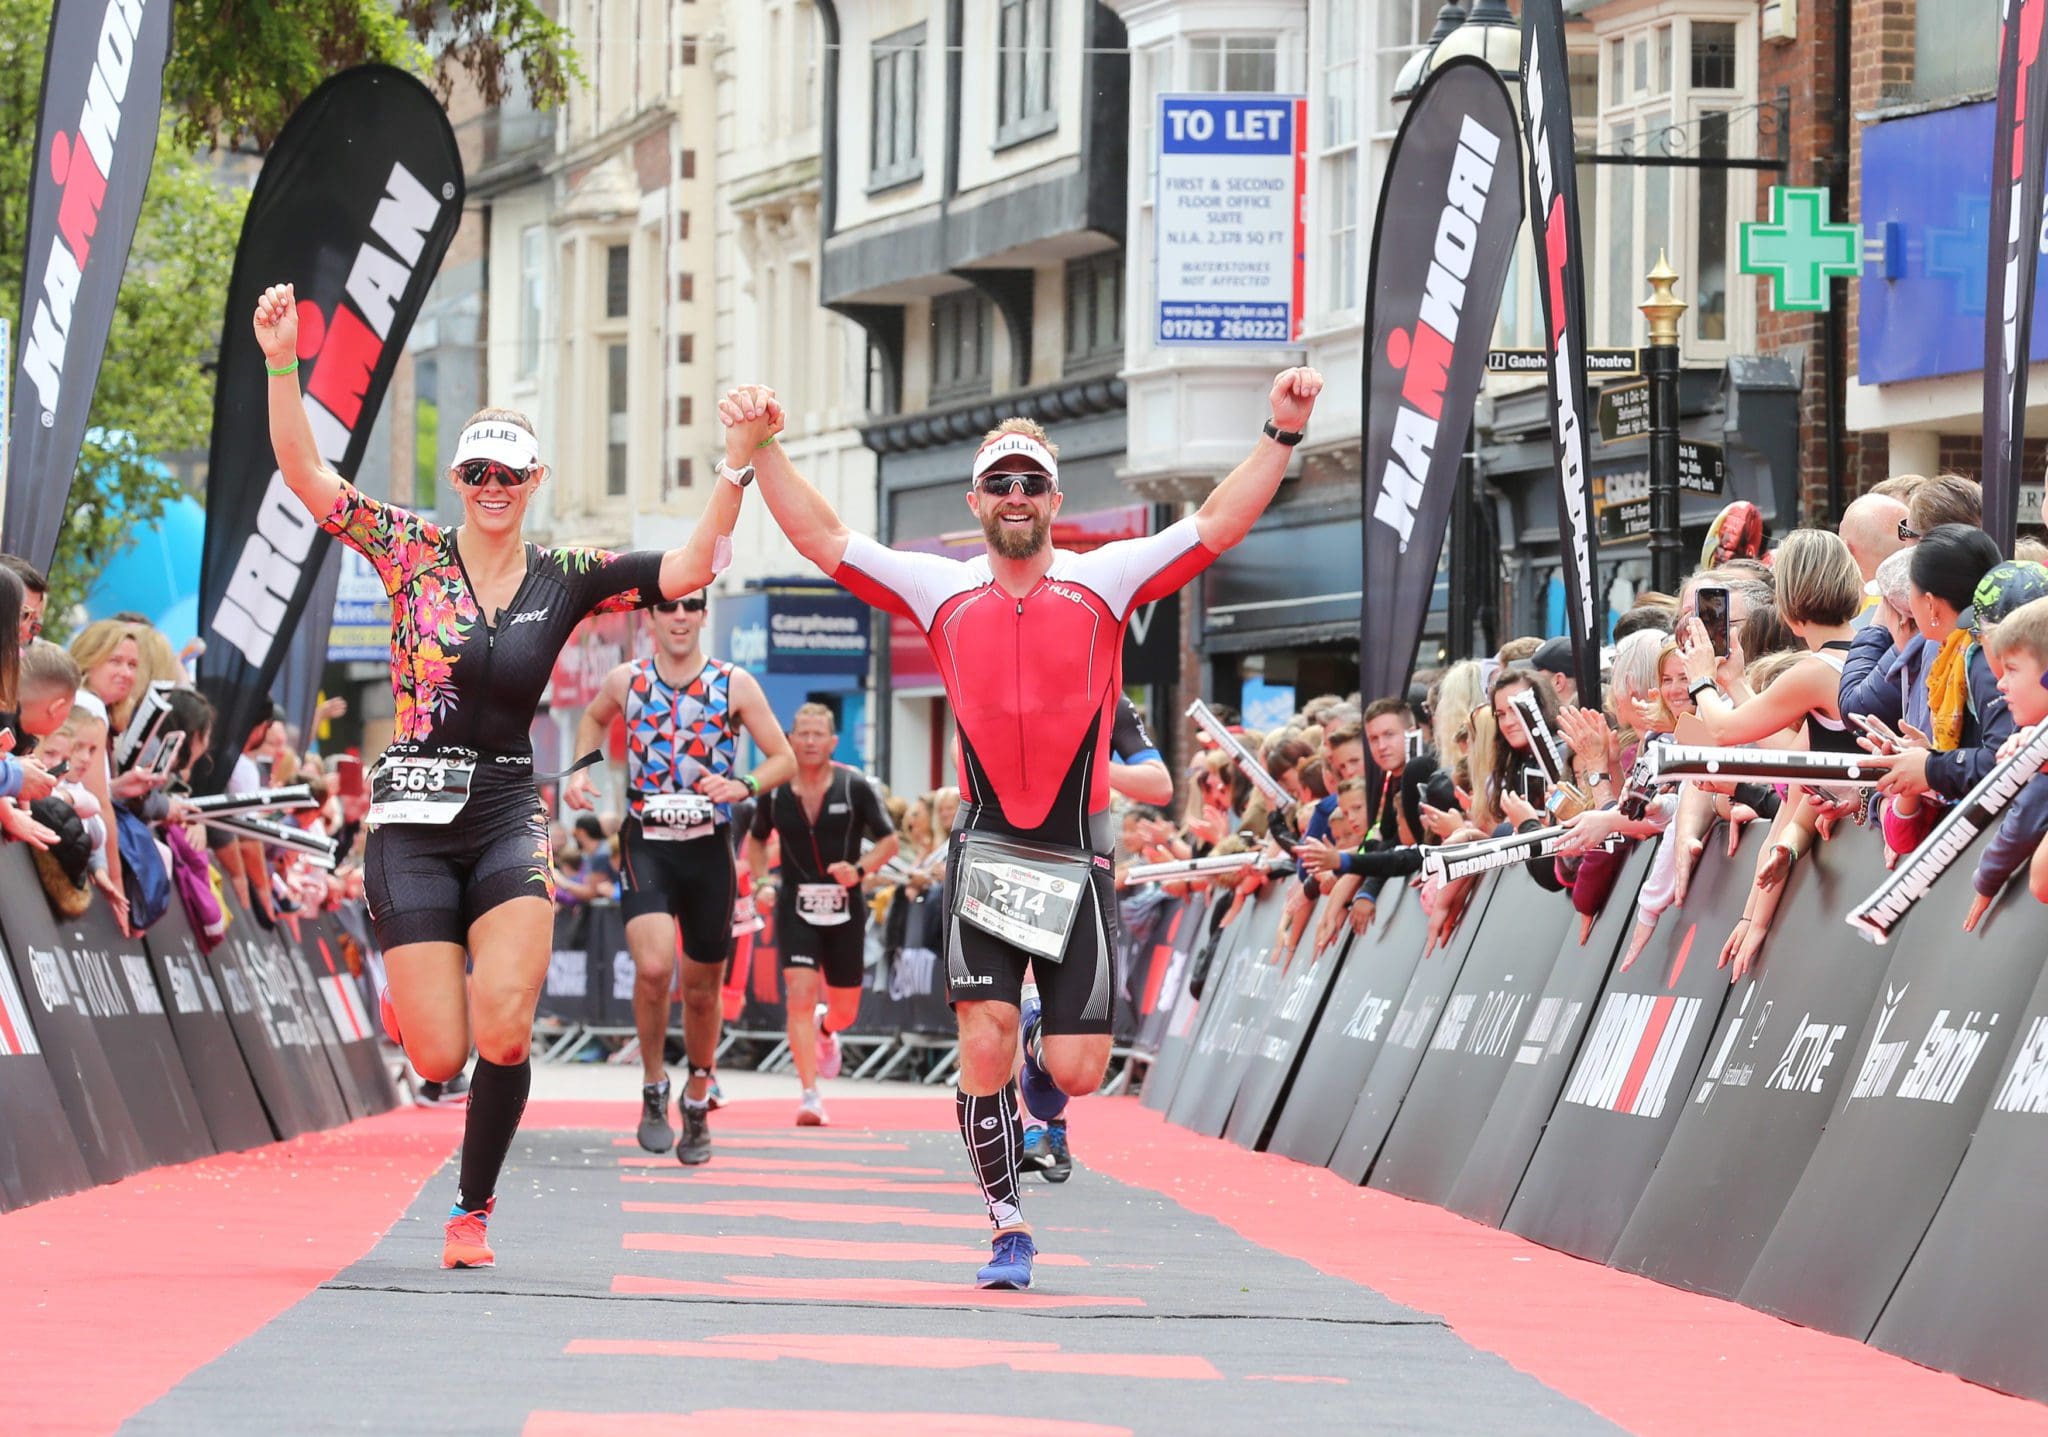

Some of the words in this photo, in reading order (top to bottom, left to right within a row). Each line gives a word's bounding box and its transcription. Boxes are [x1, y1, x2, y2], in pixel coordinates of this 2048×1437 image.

[1167, 109, 1215, 141] TO
[1225, 109, 1285, 141] LET
[1166, 178, 1204, 190] FIRST
[1210, 178, 1220, 190] &
[1227, 178, 1285, 191] SECOND
[1178, 196, 1221, 208] FLOOR
[1226, 196, 1271, 208] OFFICE
[1207, 212, 1242, 224] SUITE
[1247, 232, 1264, 244] SQ
[1269, 232, 1283, 244] FT
[1182, 262, 1271, 272] WATERSTONES
[1181, 276, 1205, 286] NOT
[1211, 276, 1270, 286] AFFECTED
[1162, 319, 1215, 338] 01782
[1220, 320, 1287, 339] 260222
[1508, 354, 1547, 368] Gateh
[466, 428, 517, 443] HUUB
[991, 440, 1039, 455] HUUB
[1049, 583, 1083, 603] HUUB
[771, 613, 858, 635] Carphone
[772, 631, 867, 650] Warehouse
[496, 756, 531, 765] orca
[391, 767, 445, 791] 563
[403, 790, 428, 802] Amy
[651, 808, 703, 825] 1009
[1448, 843, 1531, 881] IRONMAN
[1869, 816, 1979, 929] IRONMAN
[990, 879, 1047, 916] 214
[1001, 903, 1027, 921] Ross
[952, 975, 993, 986] HUUB
[1564, 992, 1703, 1118] IRONMAN
[1765, 1011, 1848, 1093] ACTIVE
[1896, 1009, 2000, 1104] Santini
